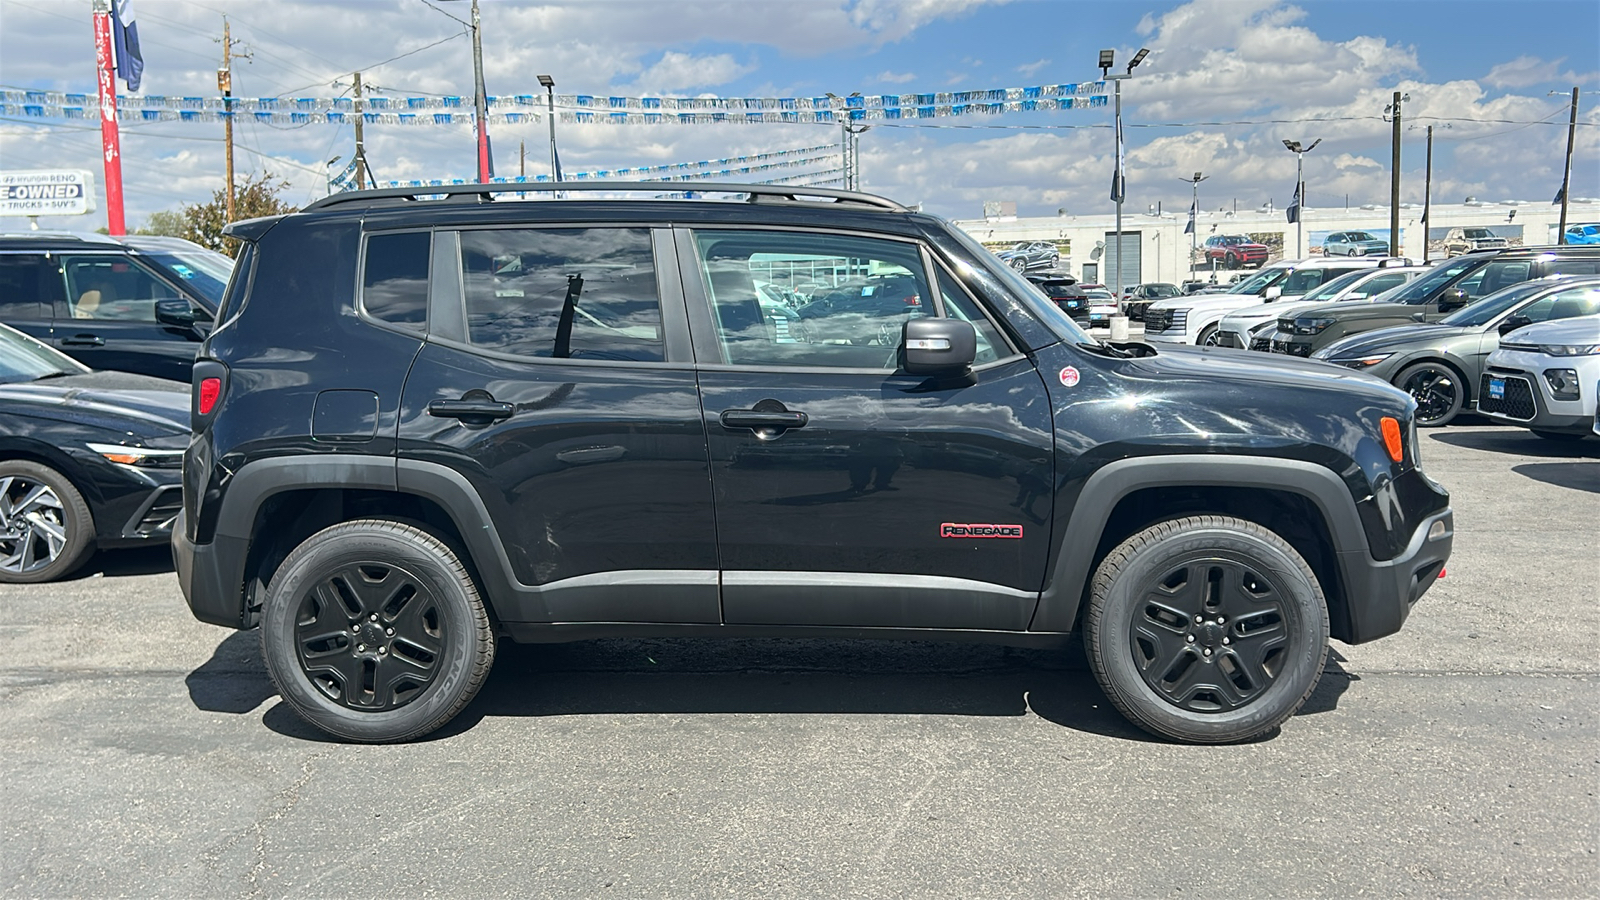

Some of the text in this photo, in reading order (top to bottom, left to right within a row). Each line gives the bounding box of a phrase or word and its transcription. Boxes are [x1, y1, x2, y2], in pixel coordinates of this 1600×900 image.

[50, 174, 76, 182] RENO
[8, 200, 76, 209] TRUCKS SUV'S
[942, 525, 1021, 537] RENEGADE
